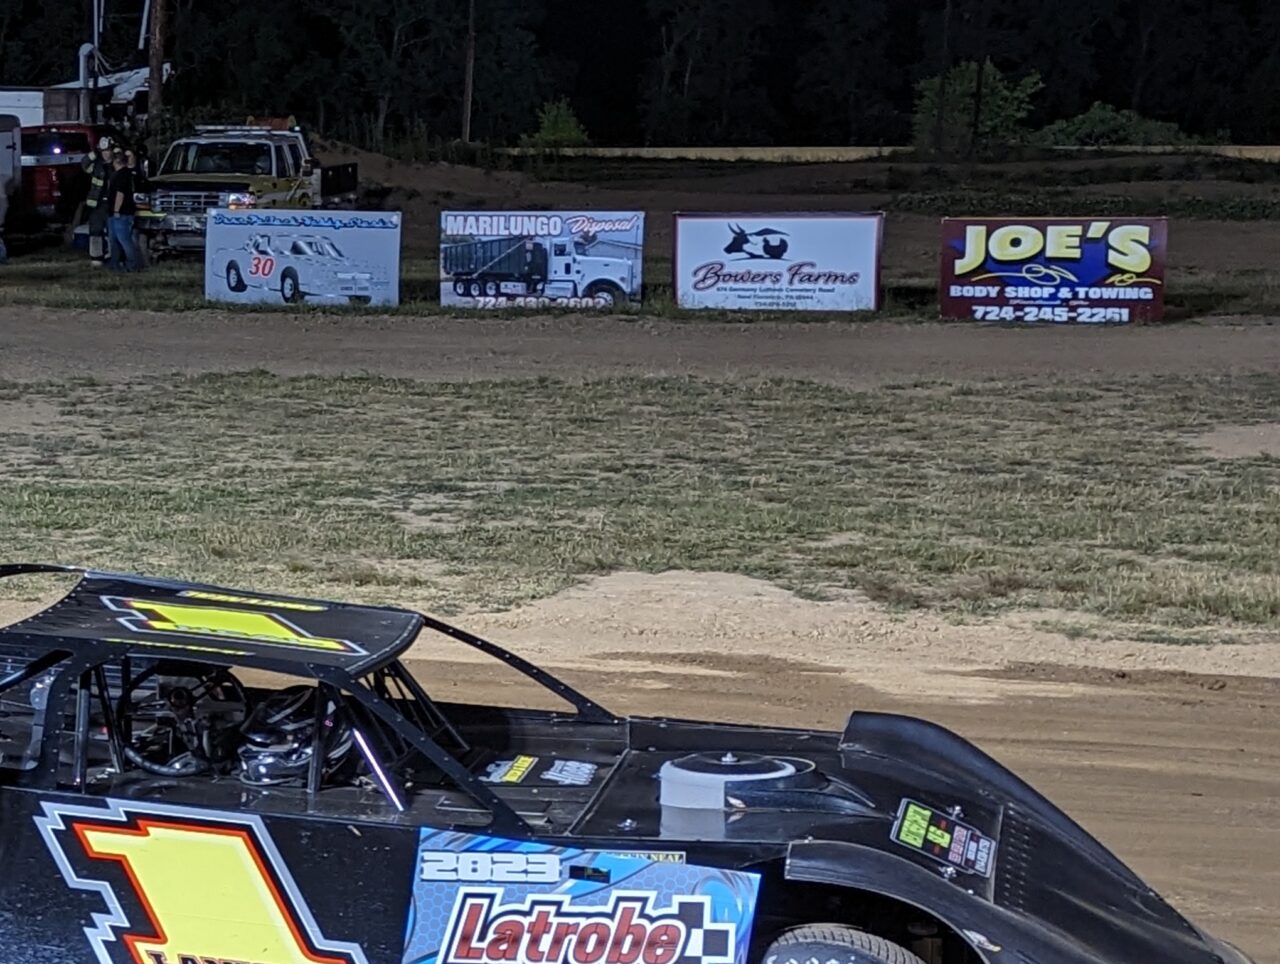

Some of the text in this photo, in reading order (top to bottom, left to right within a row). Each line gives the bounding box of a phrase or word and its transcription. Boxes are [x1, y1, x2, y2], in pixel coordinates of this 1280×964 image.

[445, 215, 639, 236] MARILUNGO Disposal
[954, 221, 1152, 275] JOE'S
[249, 256, 275, 277] 30
[692, 261, 860, 291] Bowers Farms
[950, 285, 1154, 300] BODY SHOP & TOWING
[420, 850, 561, 883] 2023
